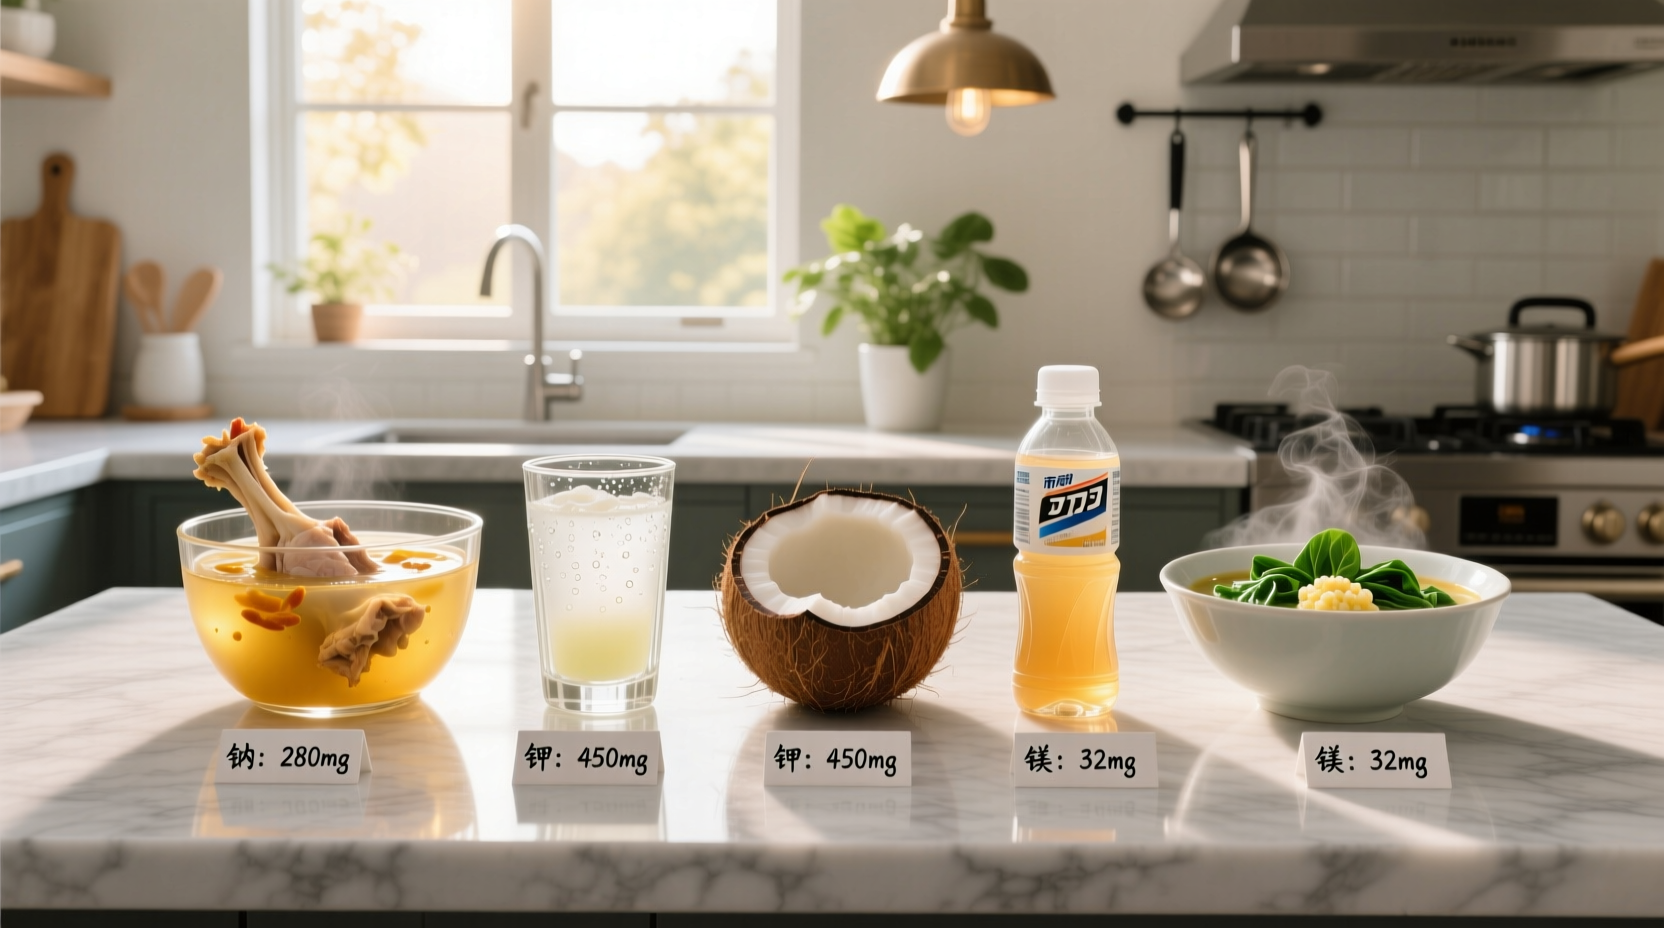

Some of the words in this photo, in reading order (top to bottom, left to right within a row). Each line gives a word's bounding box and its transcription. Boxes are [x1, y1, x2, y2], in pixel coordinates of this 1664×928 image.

[280, 745, 350, 775] 280mg
[577, 746, 648, 776] 450mg
[826, 747, 897, 777] 450mg
[1079, 748, 1136, 778] 32mg
[1370, 748, 1428, 778] 32mg
